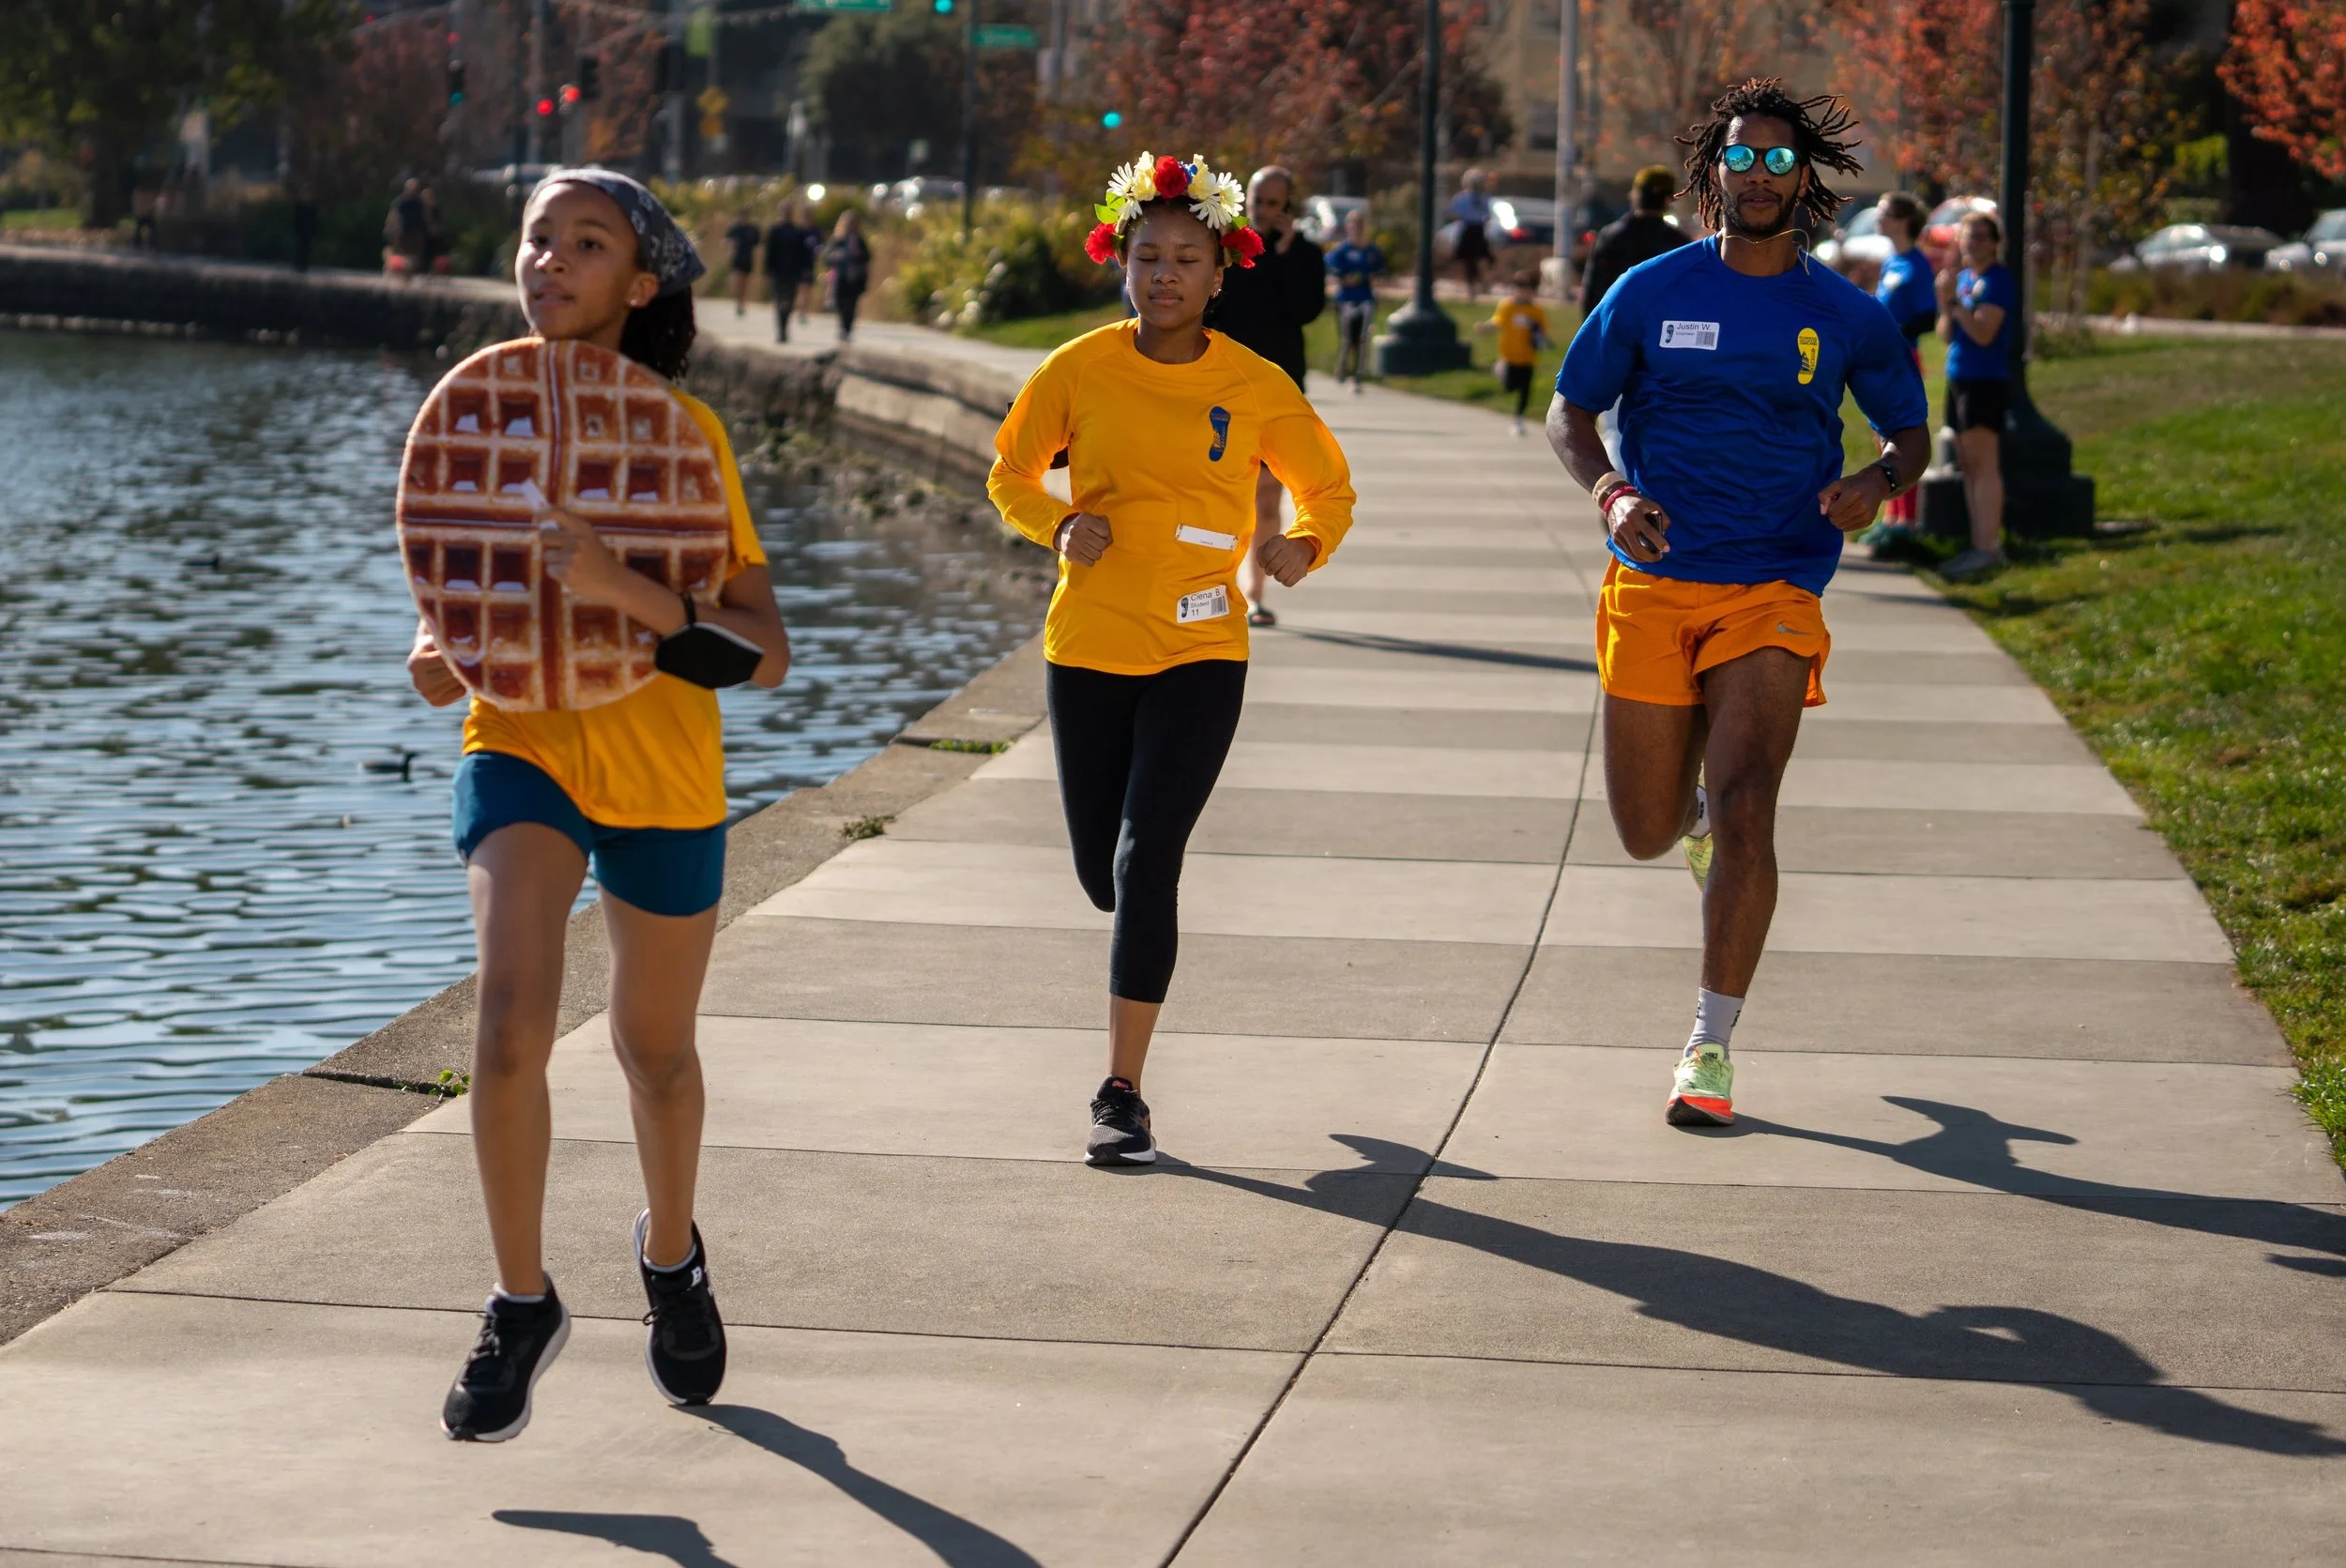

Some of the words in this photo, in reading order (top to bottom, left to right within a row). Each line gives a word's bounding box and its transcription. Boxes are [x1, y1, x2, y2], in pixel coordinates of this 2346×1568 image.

[1676, 322, 1699, 330] Justin
[1701, 323, 1712, 331] W.
[1192, 608, 1199, 617] 11
